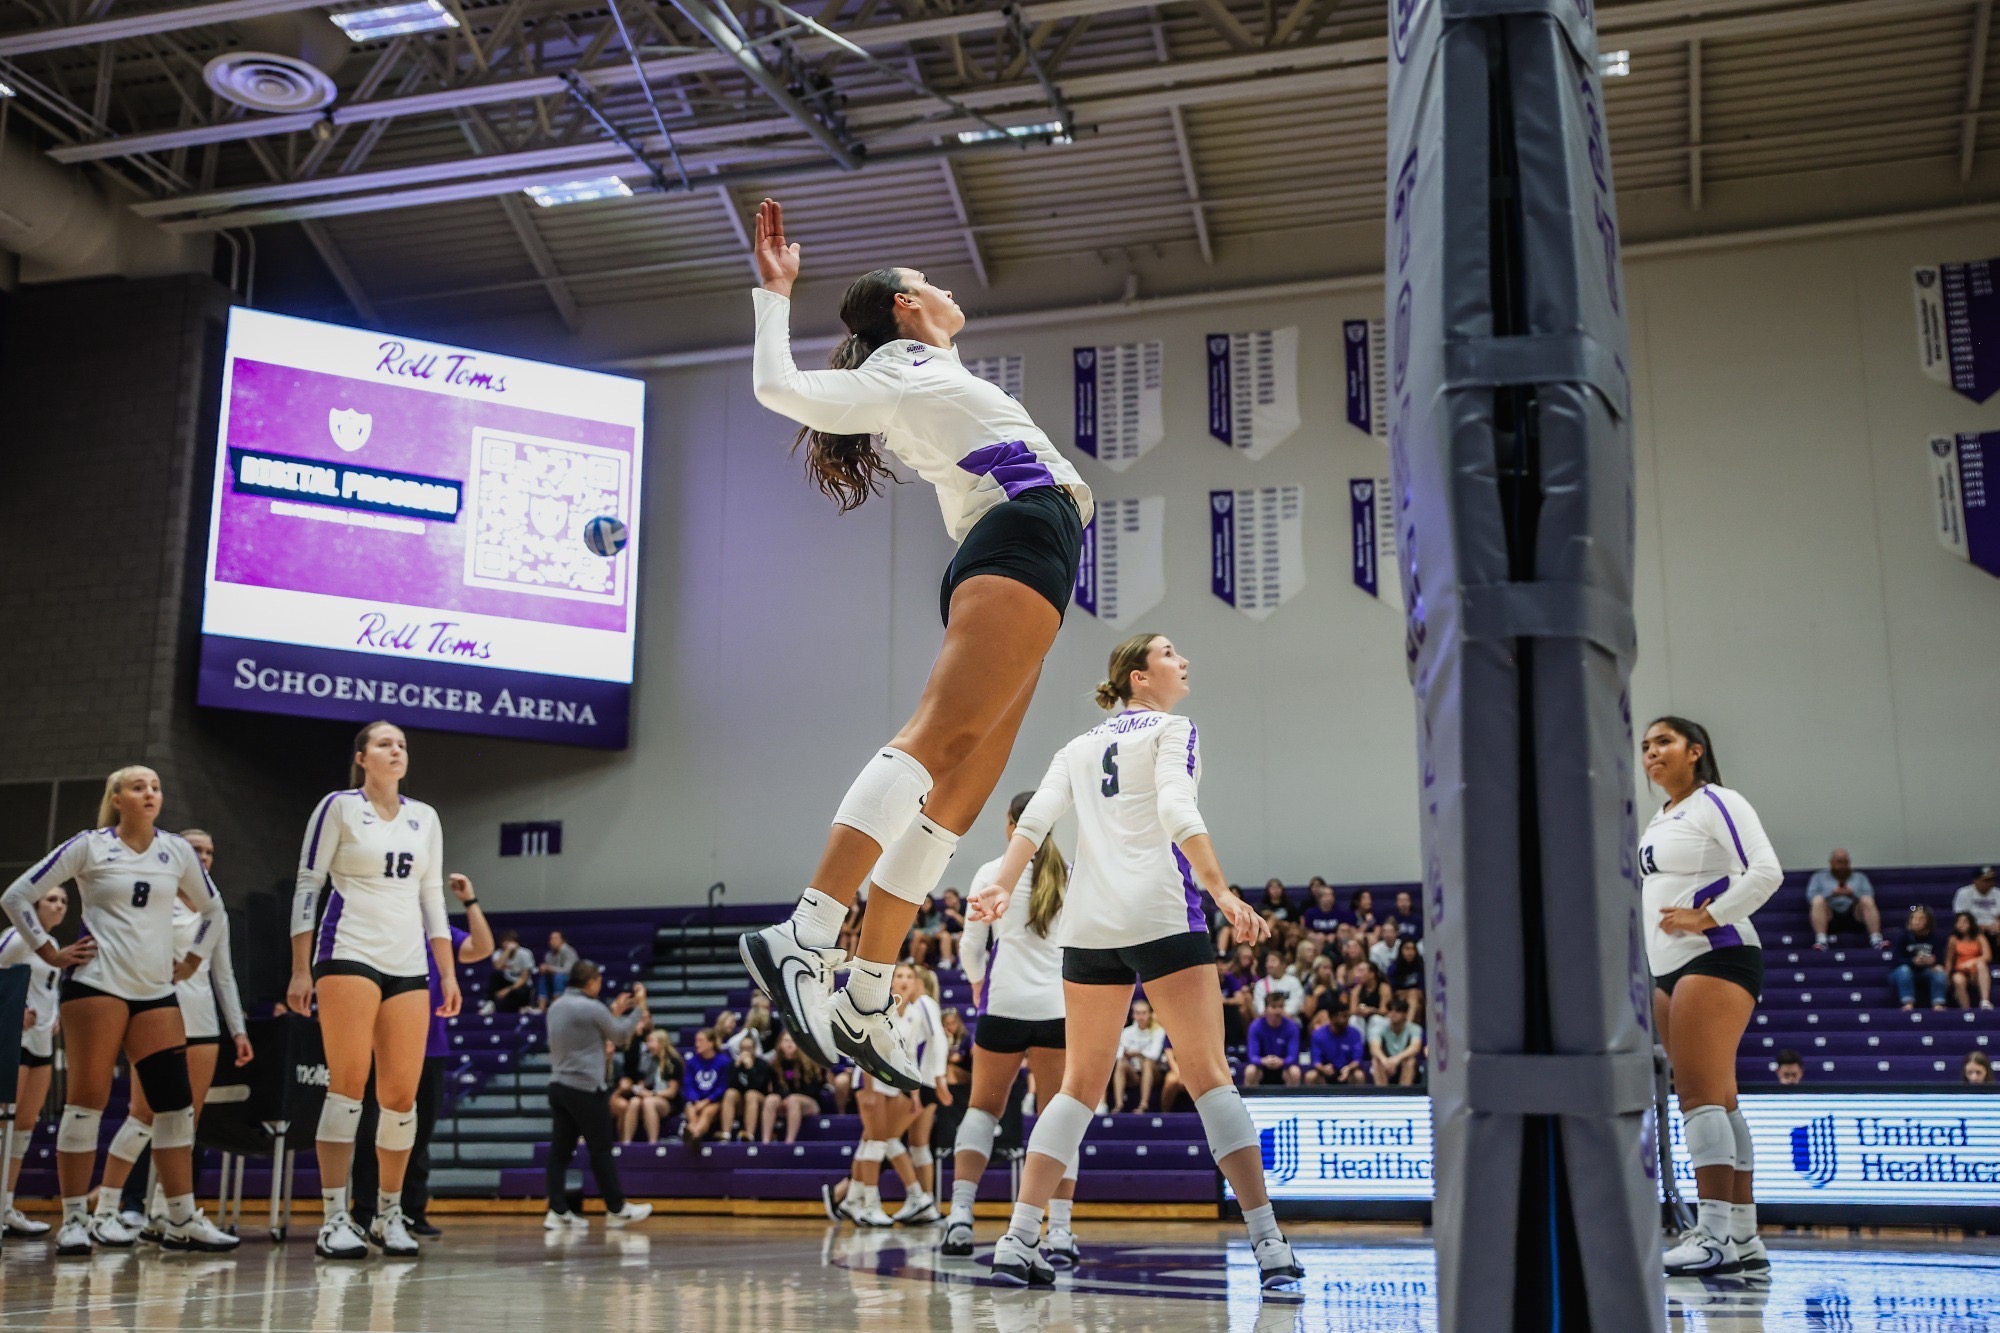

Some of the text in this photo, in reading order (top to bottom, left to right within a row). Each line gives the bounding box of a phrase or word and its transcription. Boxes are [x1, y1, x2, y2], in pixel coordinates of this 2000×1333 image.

[376, 341, 506, 392] Roll Toms
[356, 612, 491, 659] Roll Toms
[234, 658, 597, 725] SCHOENECKER ARENA
[1101, 742, 1120, 798] 5
[384, 851, 414, 879] 16
[132, 881, 151, 908] 8
[1317, 1118, 1414, 1146] United
[1856, 1117, 1968, 1147] United
